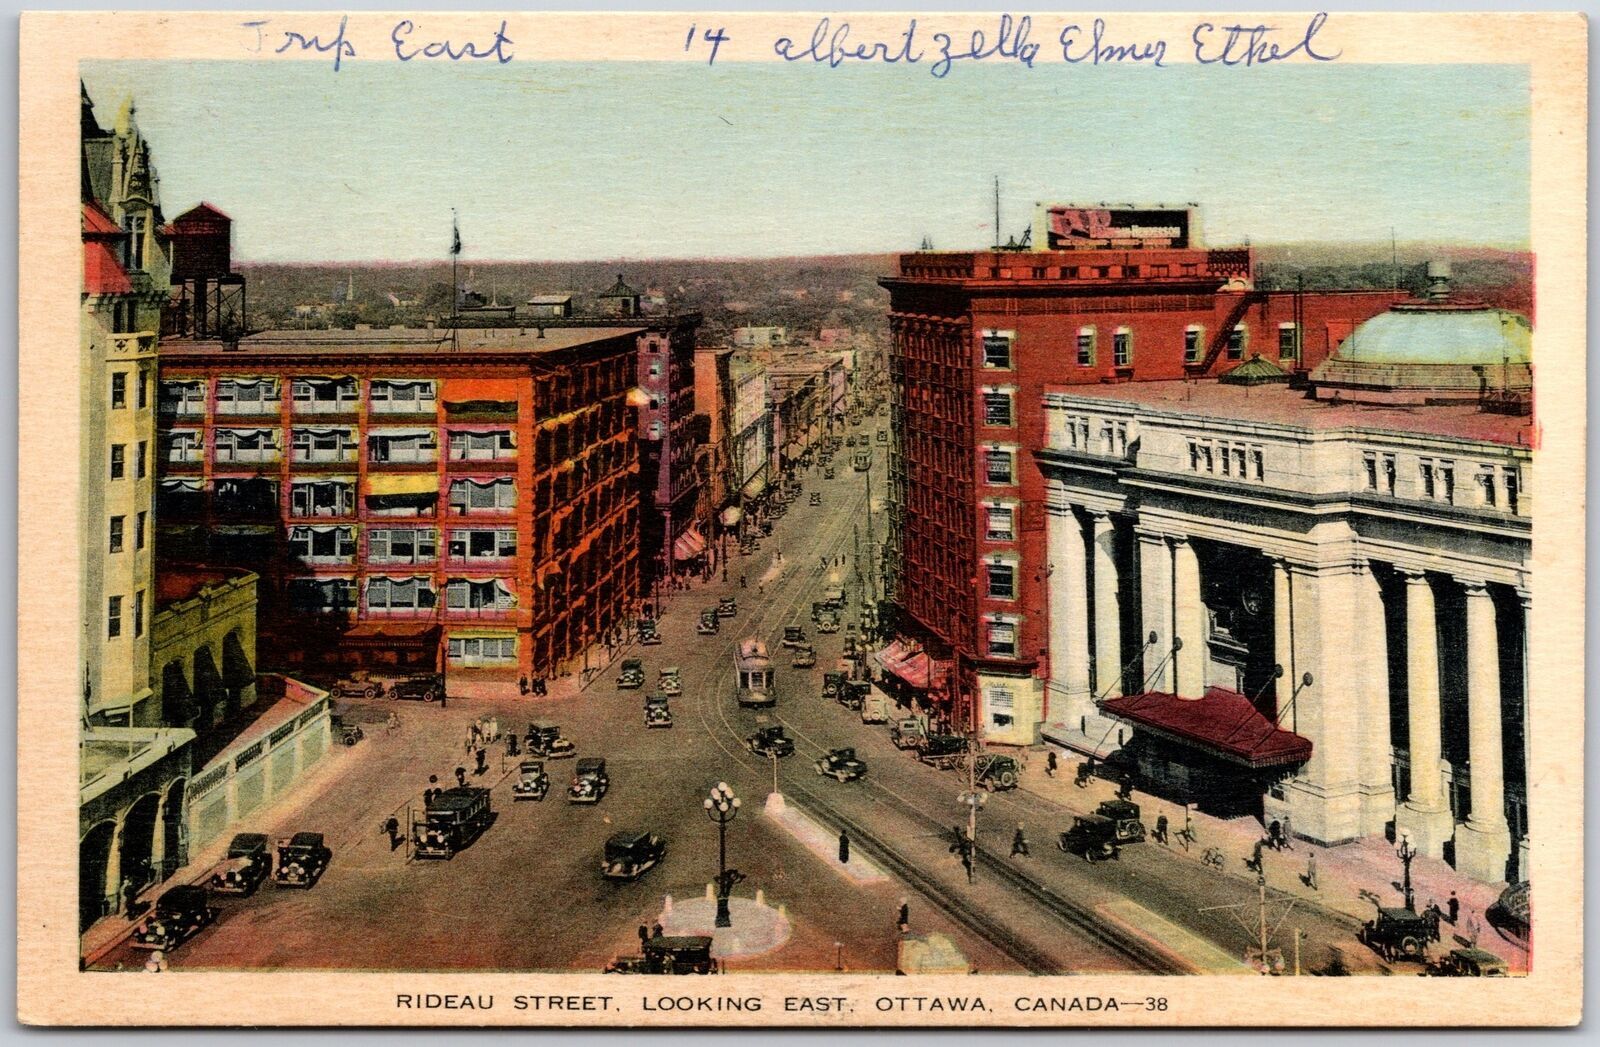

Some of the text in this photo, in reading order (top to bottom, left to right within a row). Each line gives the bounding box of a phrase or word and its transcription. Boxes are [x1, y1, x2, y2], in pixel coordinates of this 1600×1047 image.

[391, 19, 515, 64] East
[684, 23, 731, 66] 14
[1058, 17, 1168, 69] Elmer
[1192, 11, 1344, 68] Ethel
